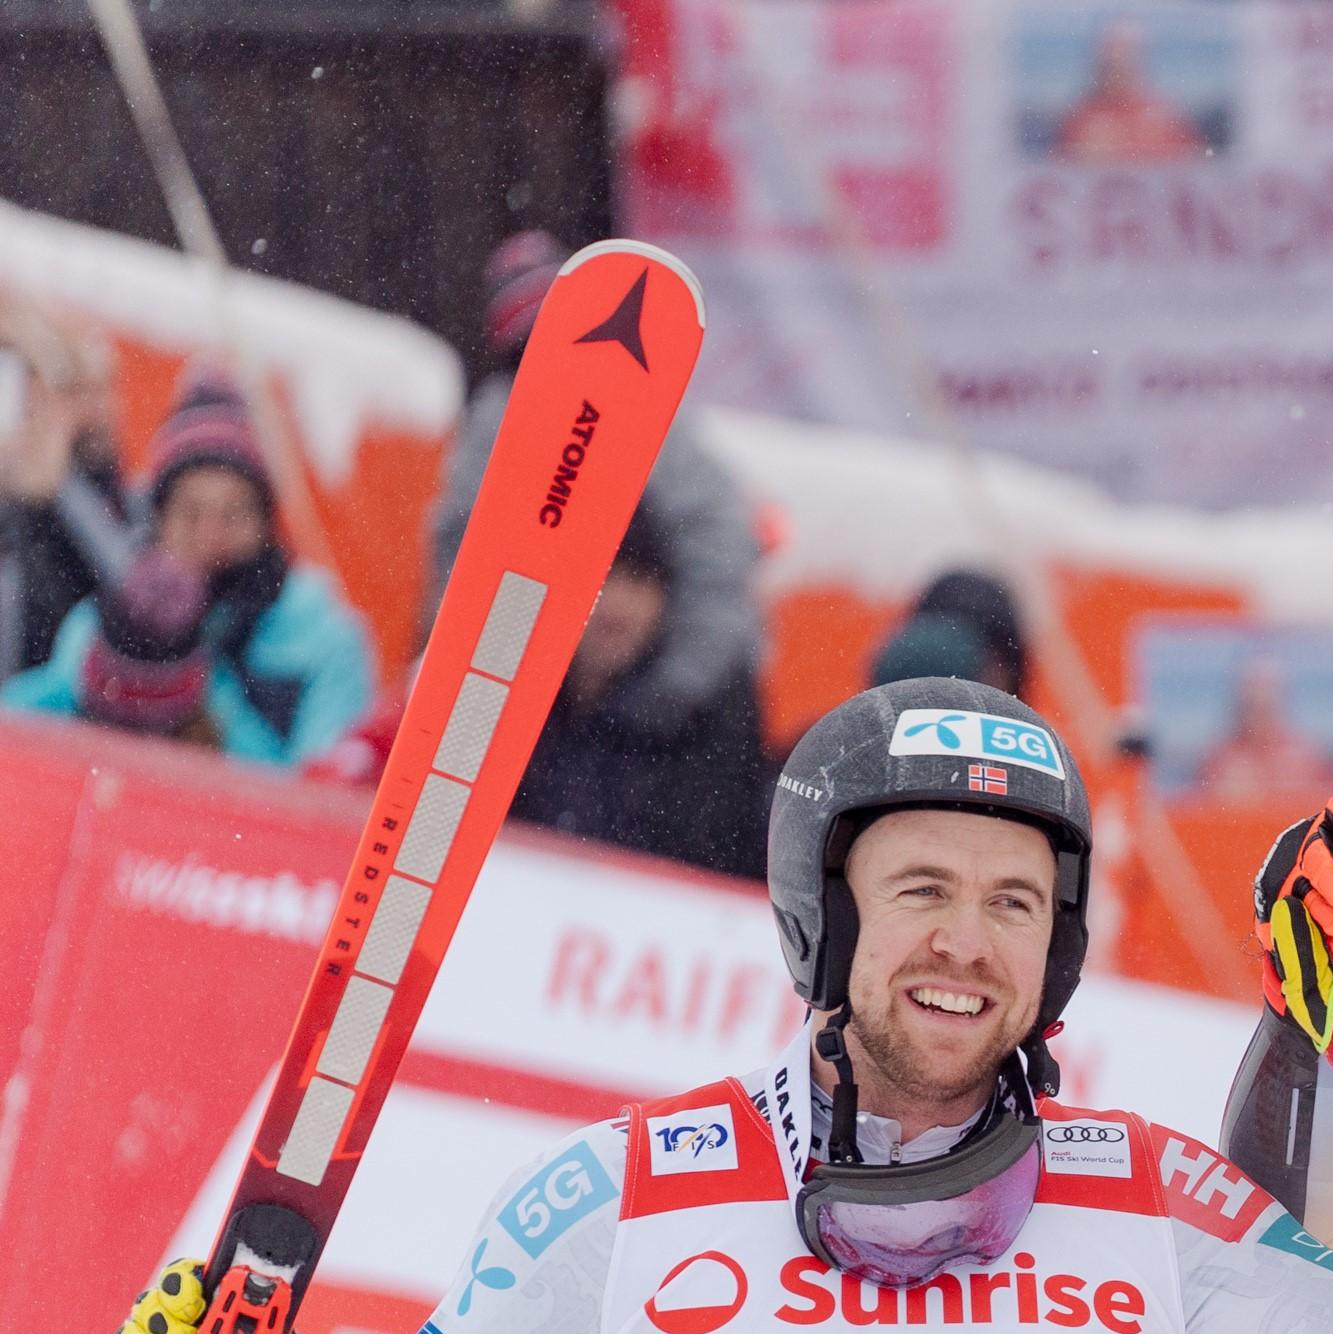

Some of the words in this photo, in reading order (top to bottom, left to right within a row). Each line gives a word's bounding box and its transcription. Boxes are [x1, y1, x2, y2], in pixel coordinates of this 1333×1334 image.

[538, 400, 600, 530] ATOMIC
[990, 725, 1048, 759] 5G
[326, 816, 398, 977] REDSTER
[514, 1165, 593, 1239] 5G
